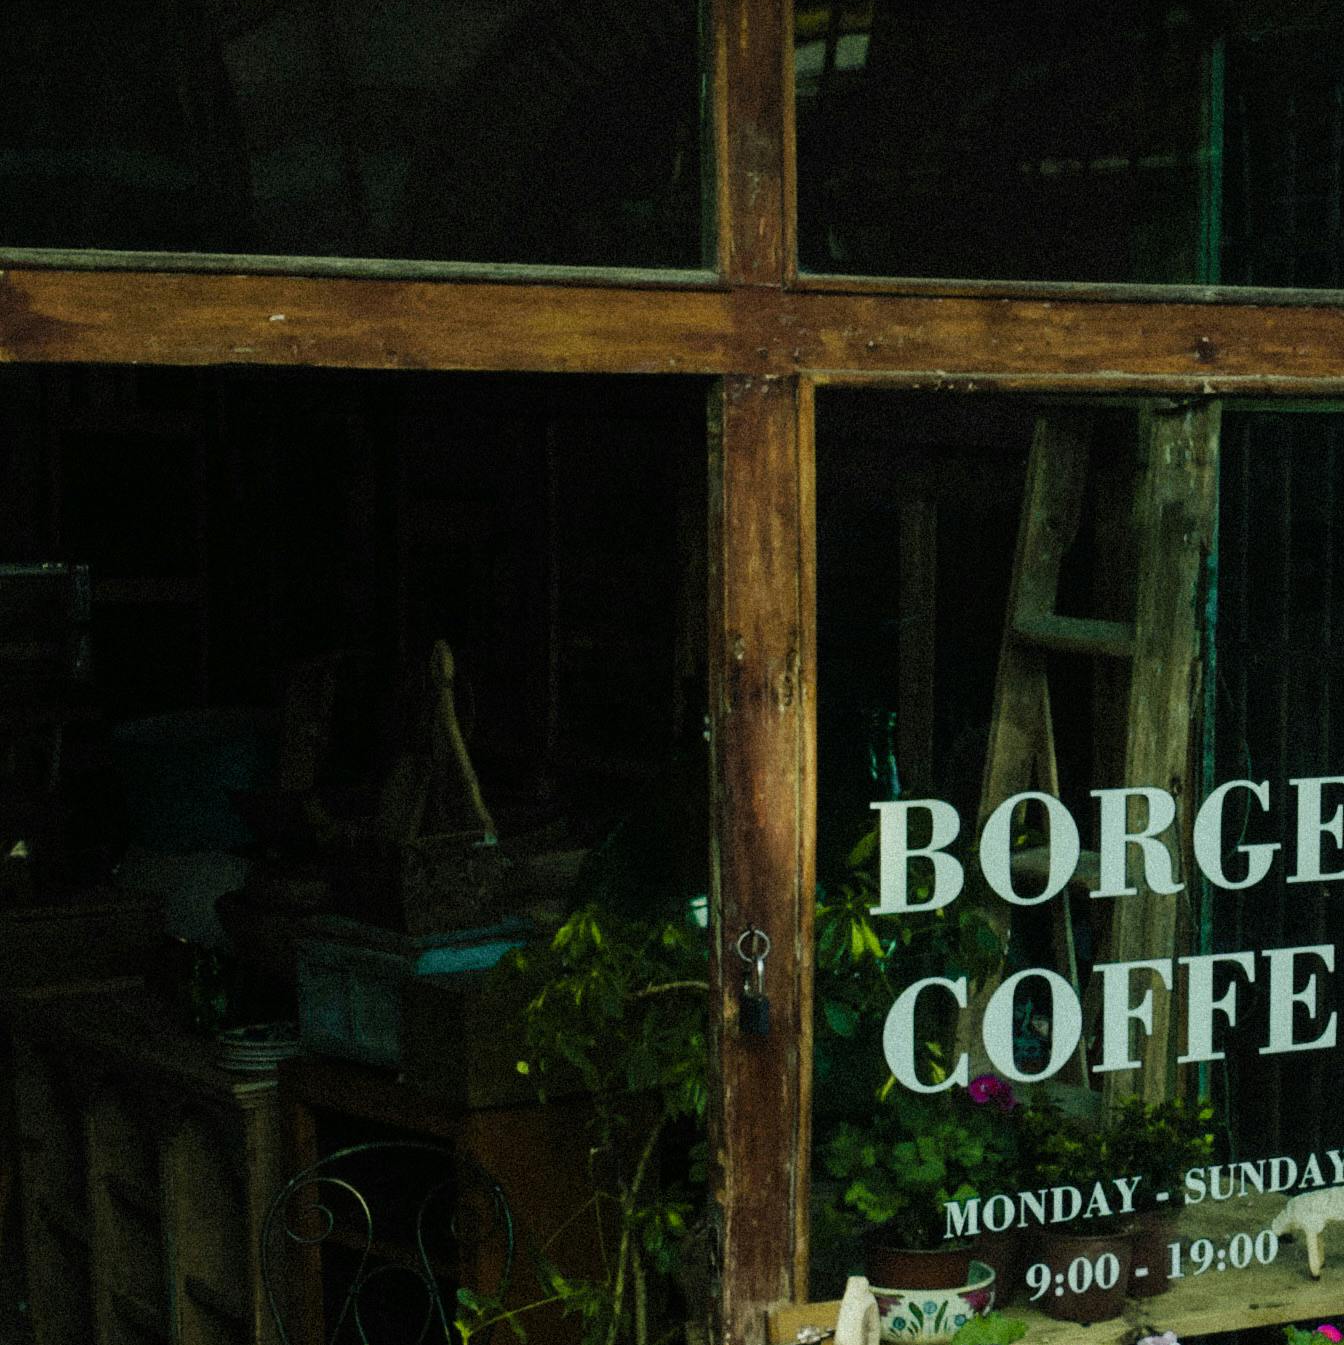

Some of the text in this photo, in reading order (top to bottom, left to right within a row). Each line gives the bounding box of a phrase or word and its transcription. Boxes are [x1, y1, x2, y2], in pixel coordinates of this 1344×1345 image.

[943, 1175, 1142, 1239] MONDAY
[1025, 1253, 1120, 1302] 9:00
[1166, 1229, 1279, 1279] 19:00
